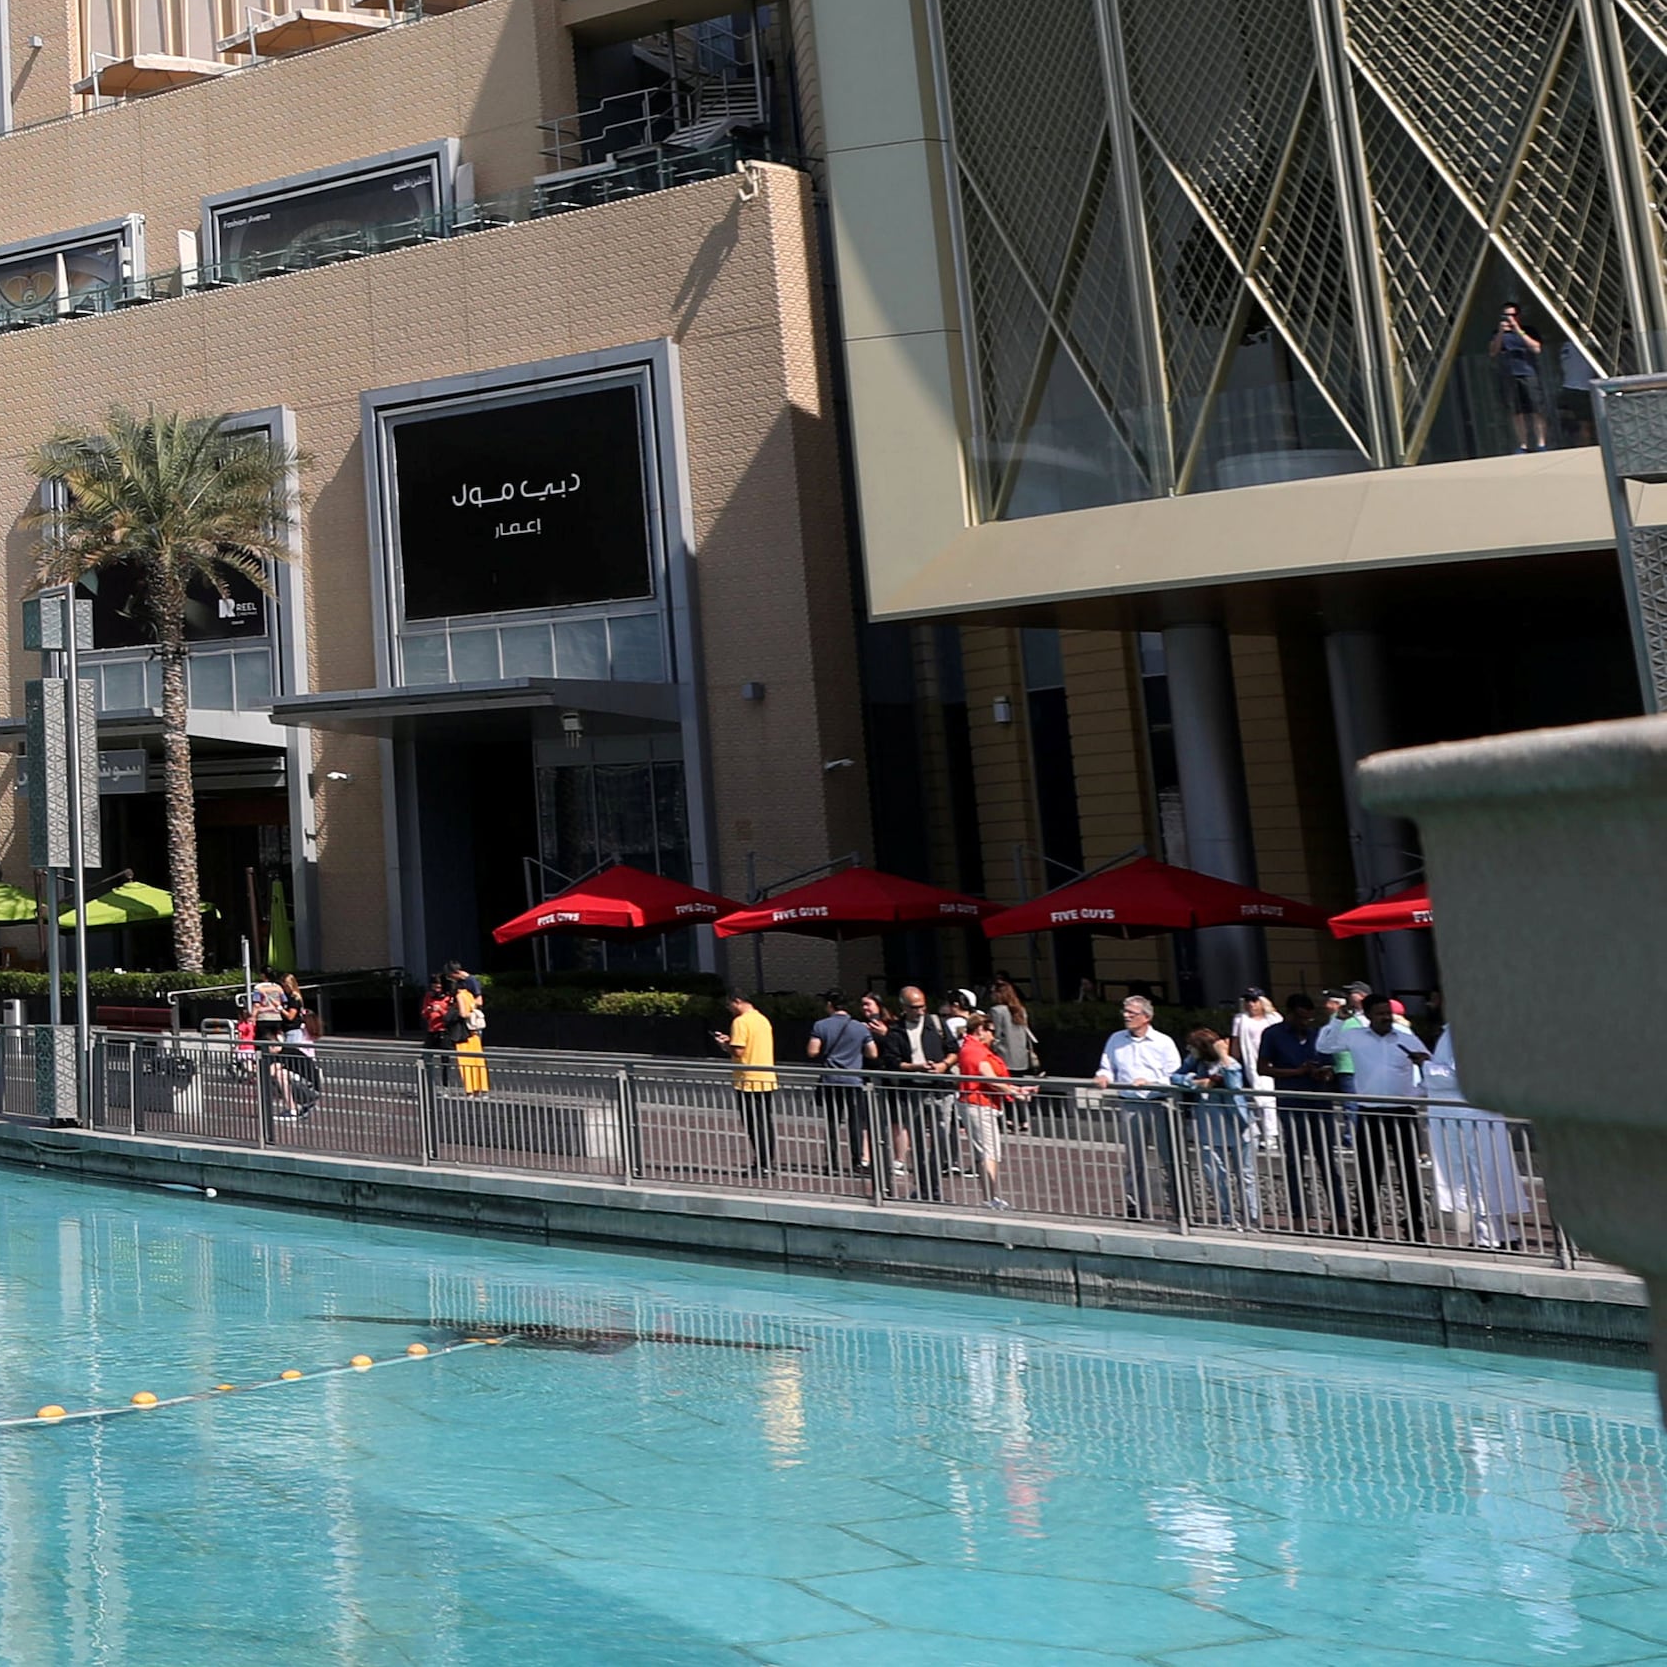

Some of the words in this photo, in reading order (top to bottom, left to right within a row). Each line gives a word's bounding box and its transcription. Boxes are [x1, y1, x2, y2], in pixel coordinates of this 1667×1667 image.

[452, 482, 514, 508] مول
[520, 473, 581, 501] دبي
[494, 518, 541, 539] إعمار
[773, 909, 797, 921] FIVE
[799, 906, 829, 917] GUYS
[1051, 909, 1079, 922] FIVE
[1081, 908, 1115, 919] GUYS
